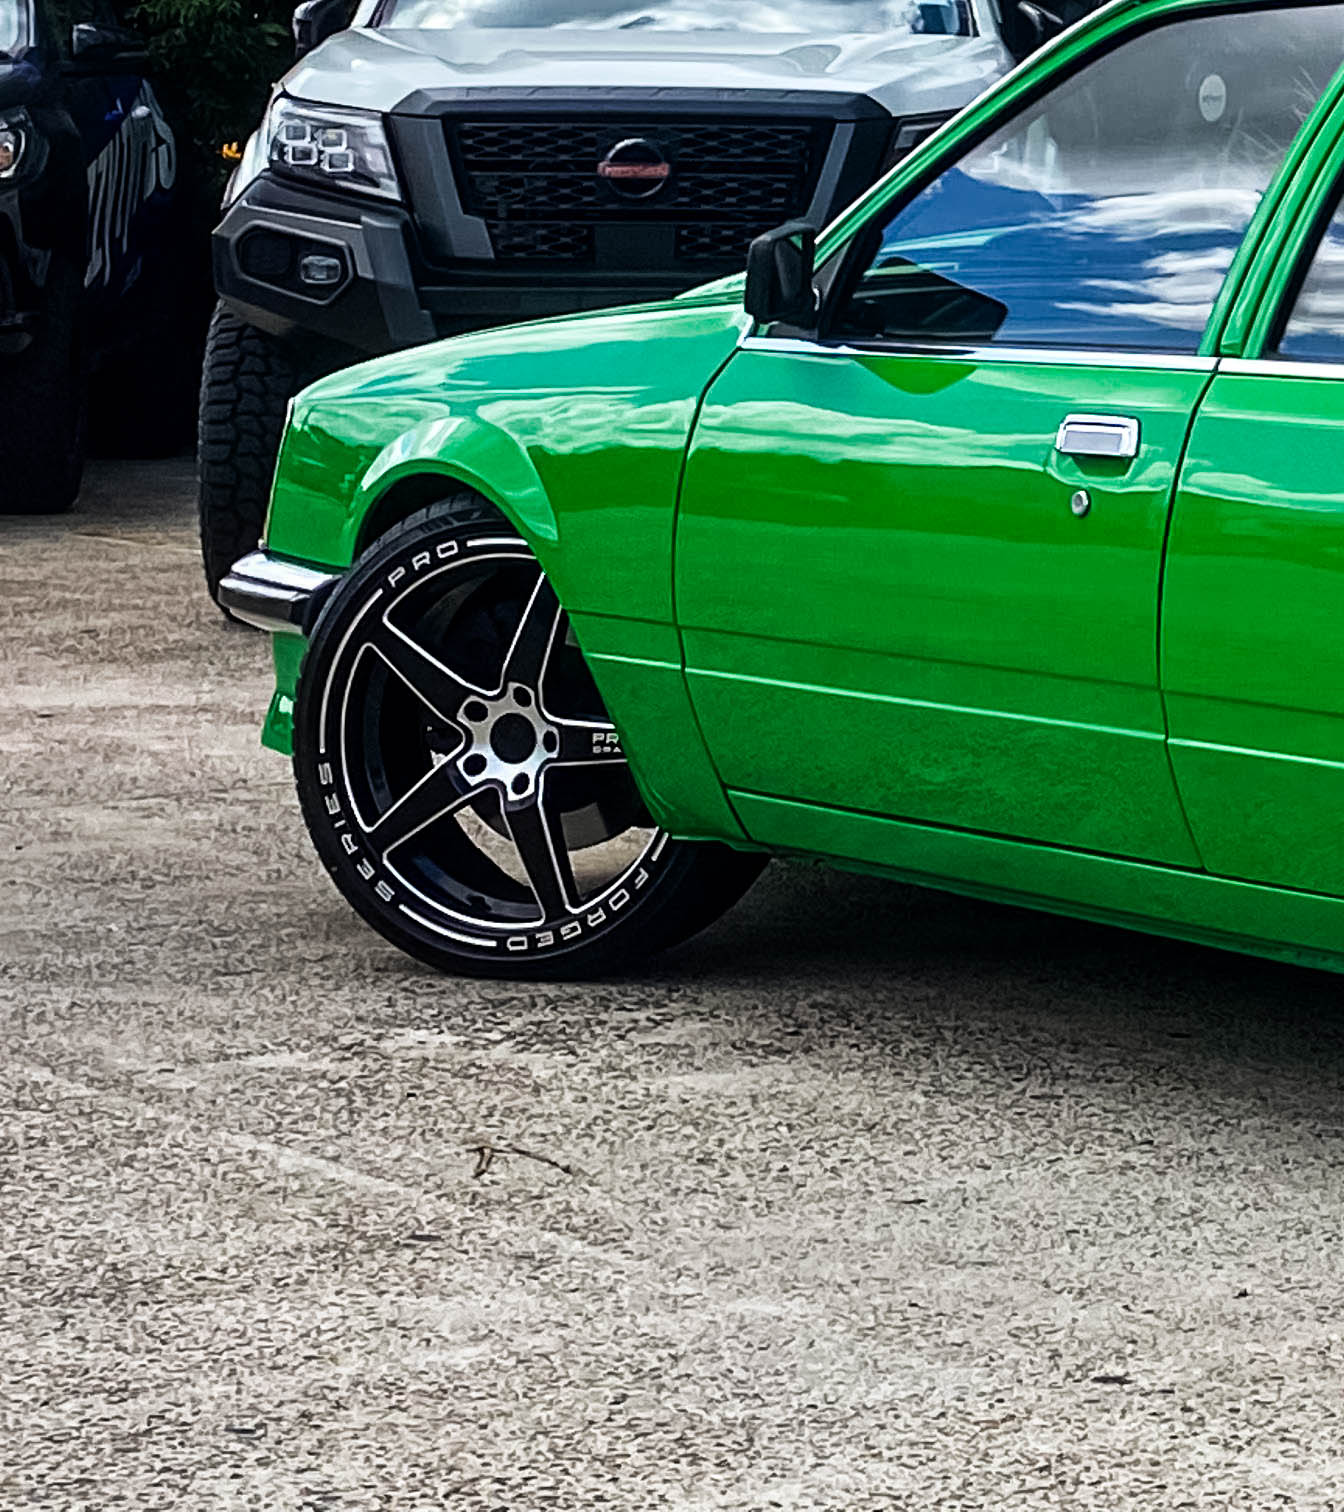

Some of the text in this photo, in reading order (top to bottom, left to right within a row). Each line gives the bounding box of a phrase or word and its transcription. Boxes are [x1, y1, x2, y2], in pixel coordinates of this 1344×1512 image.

[387, 540, 459, 588] PRO
[317, 761, 396, 903] SERIES
[506, 867, 647, 952] FORGED
